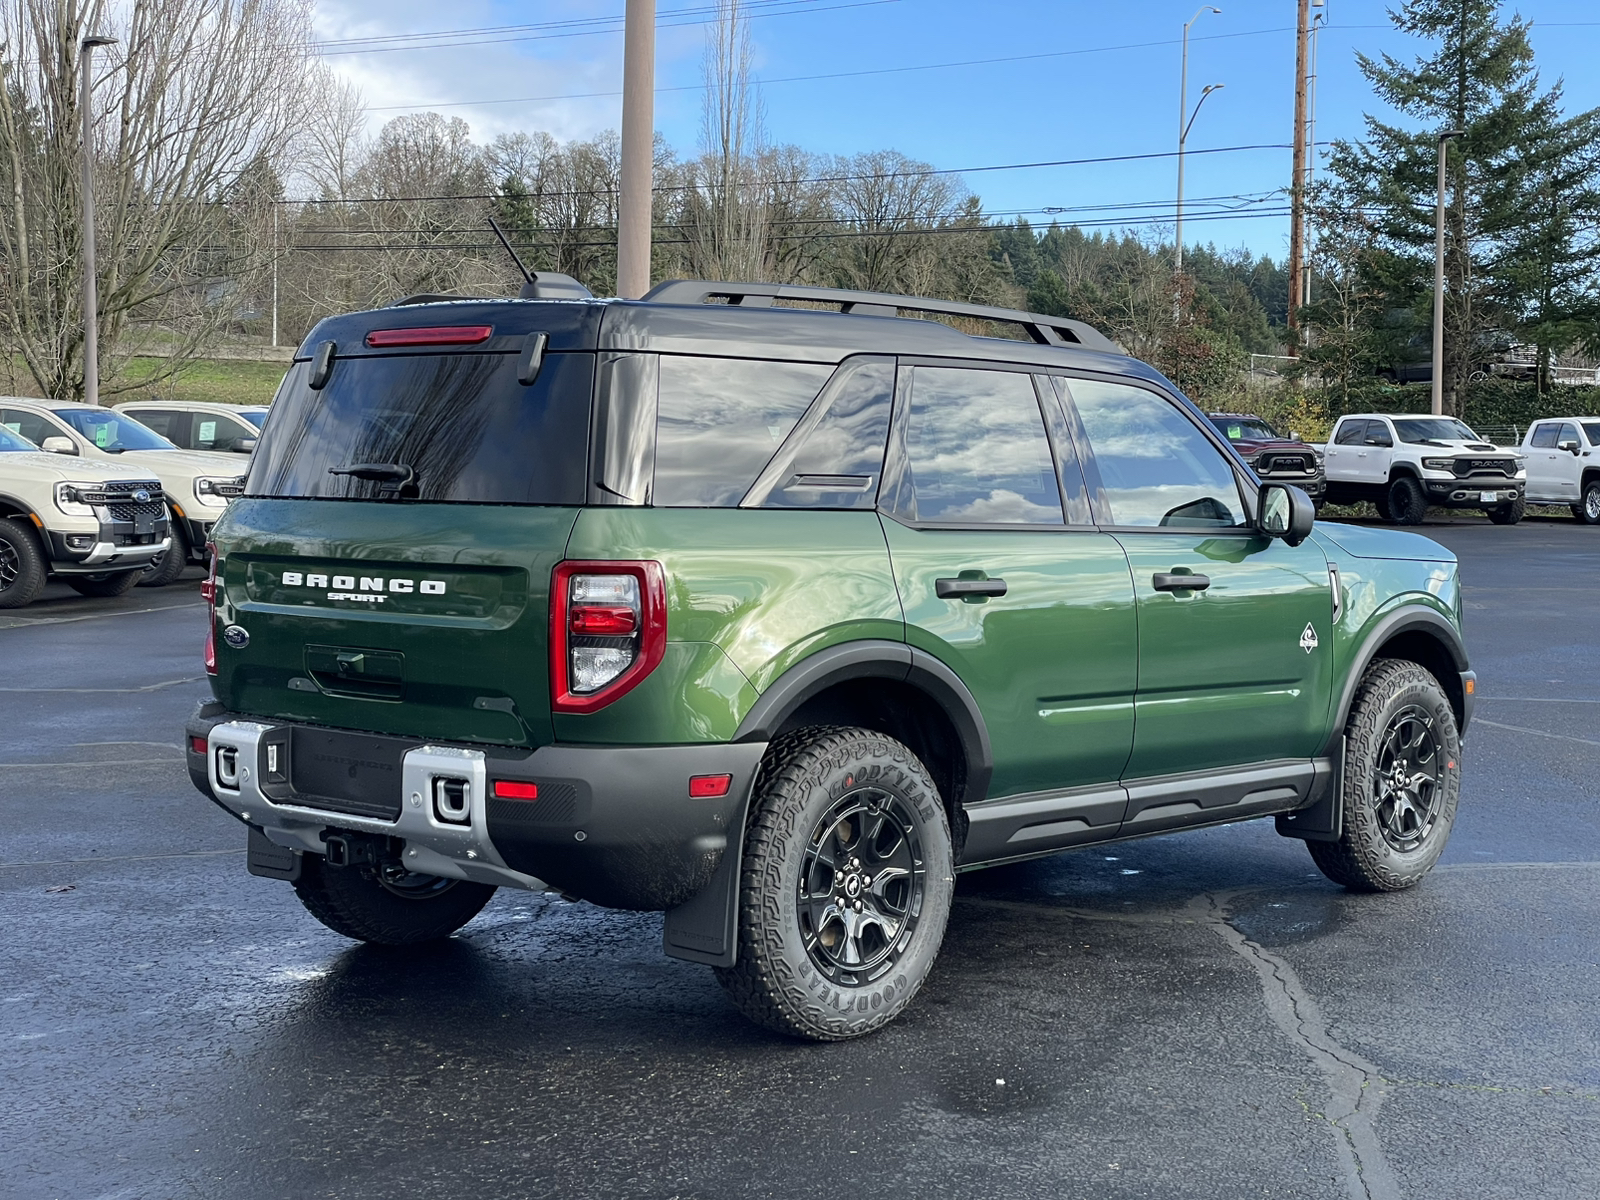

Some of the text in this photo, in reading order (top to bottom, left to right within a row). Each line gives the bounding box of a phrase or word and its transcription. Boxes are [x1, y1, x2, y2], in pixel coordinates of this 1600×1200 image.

[282, 571, 446, 595] BRONCO
[327, 592, 388, 603] SPORT
[829, 765, 935, 824] GOODYEAR
[797, 960, 907, 1014] GOODYEAR
